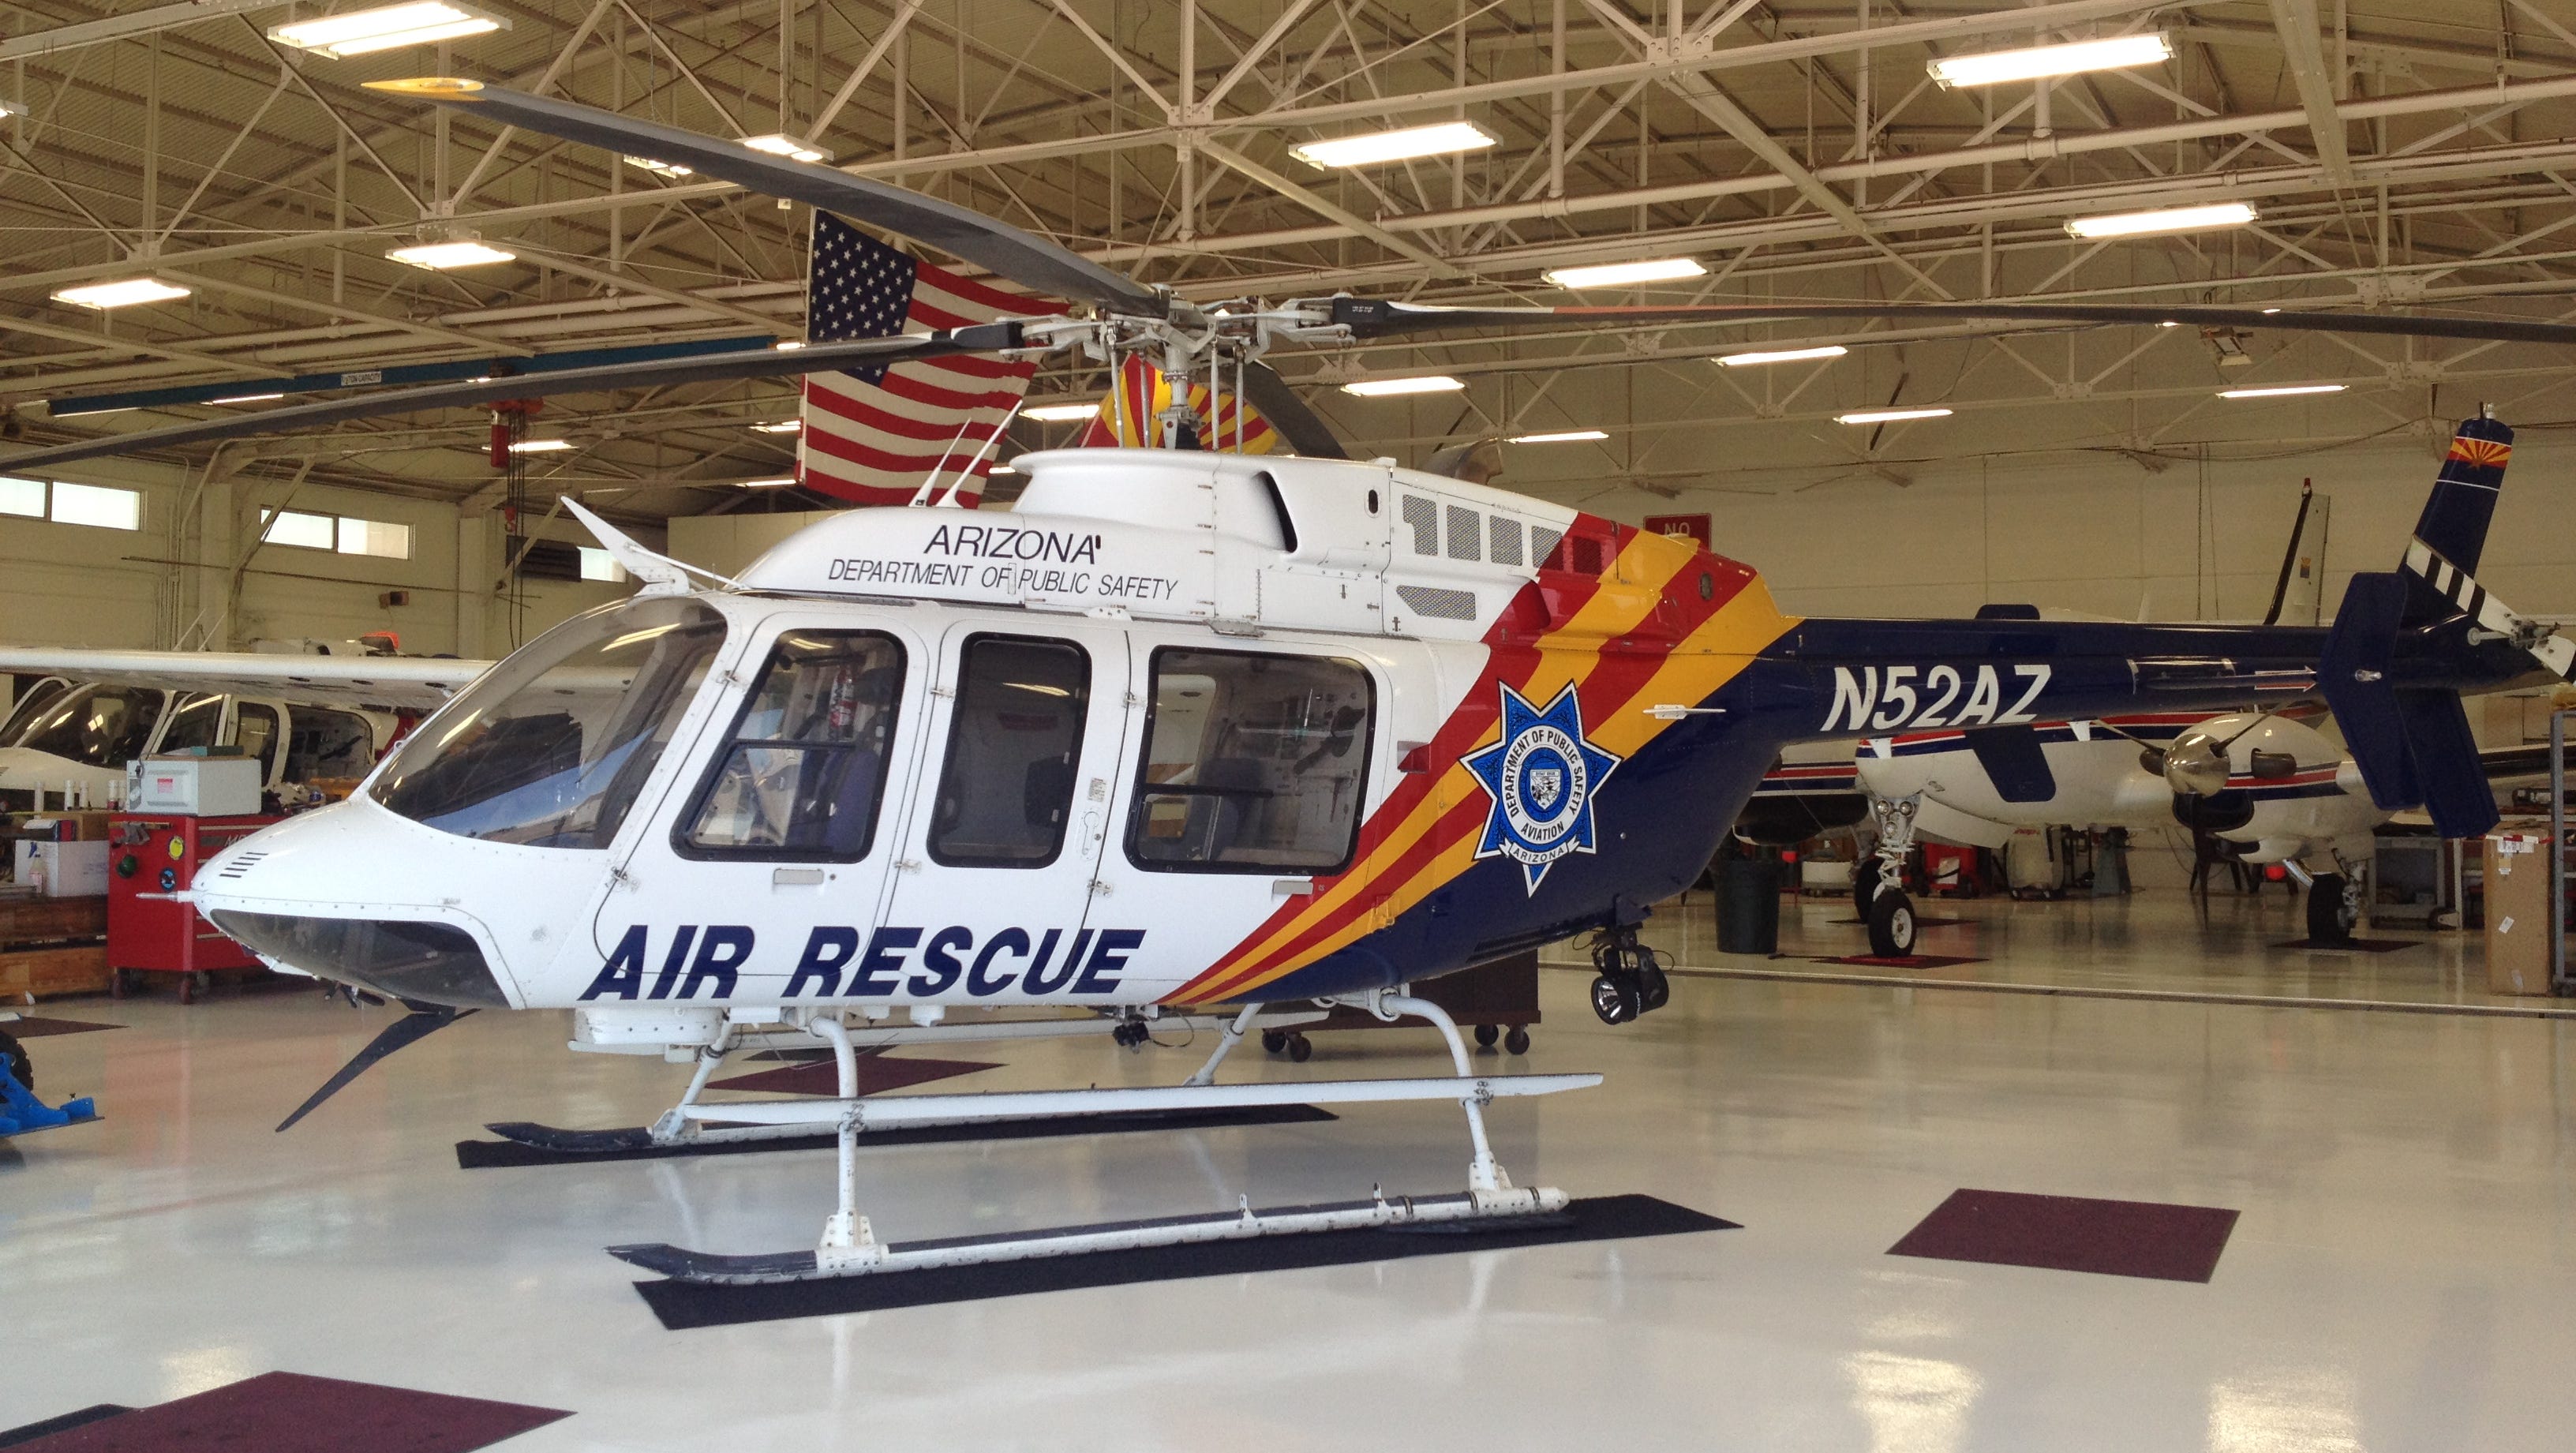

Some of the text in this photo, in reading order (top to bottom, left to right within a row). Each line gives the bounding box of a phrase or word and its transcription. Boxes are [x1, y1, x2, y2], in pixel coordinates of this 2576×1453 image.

[923, 525, 1095, 565] ARIZONA
[1664, 522, 1690, 535] NO
[829, 559, 1178, 600] DEPARTMENT OF PUBLIC SAFETY
[1820, 665, 2051, 732] N52AZ
[1504, 729, 1583, 818] DEPARTMENT OF PUBLIC SAFETY
[1520, 821, 1564, 841] AVIATION
[1513, 847, 1564, 863] ARIZONA
[578, 924, 1147, 1002] AIR RESCUE
